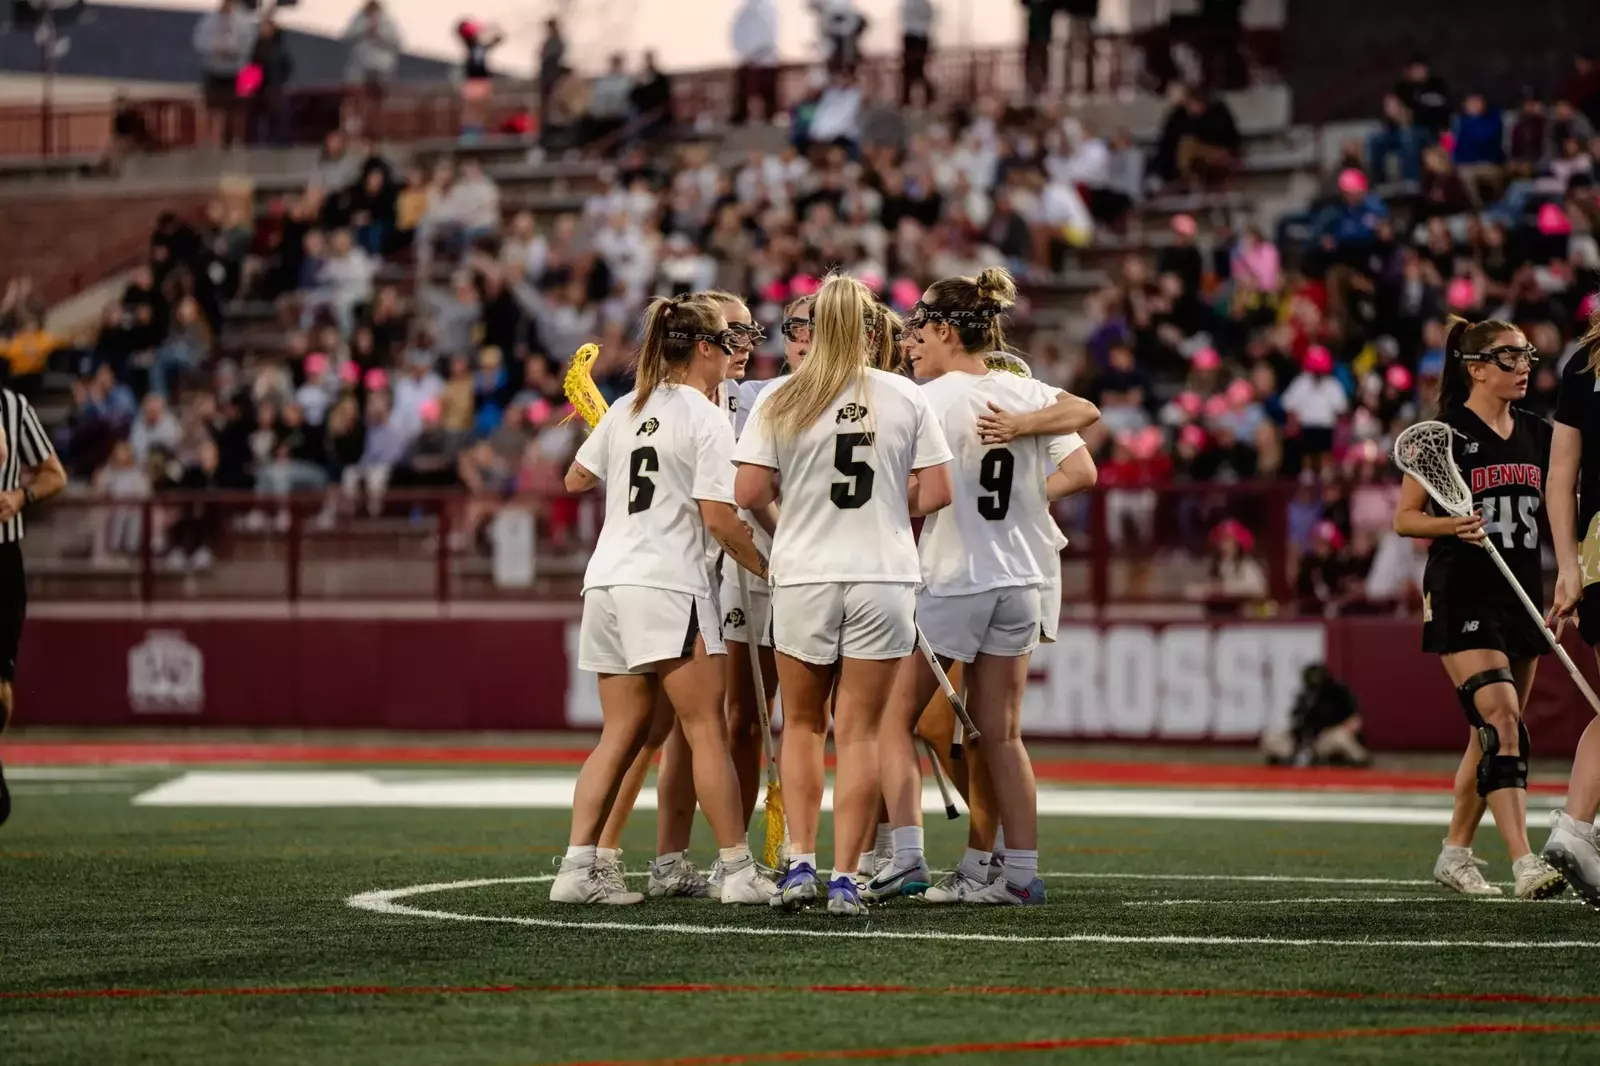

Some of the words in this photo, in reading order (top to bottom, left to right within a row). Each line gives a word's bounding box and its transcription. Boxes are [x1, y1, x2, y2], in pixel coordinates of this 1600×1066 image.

[669, 331, 689, 339] STX
[628, 446, 659, 515] 6
[830, 432, 875, 509] 5
[977, 448, 1014, 520] 9
